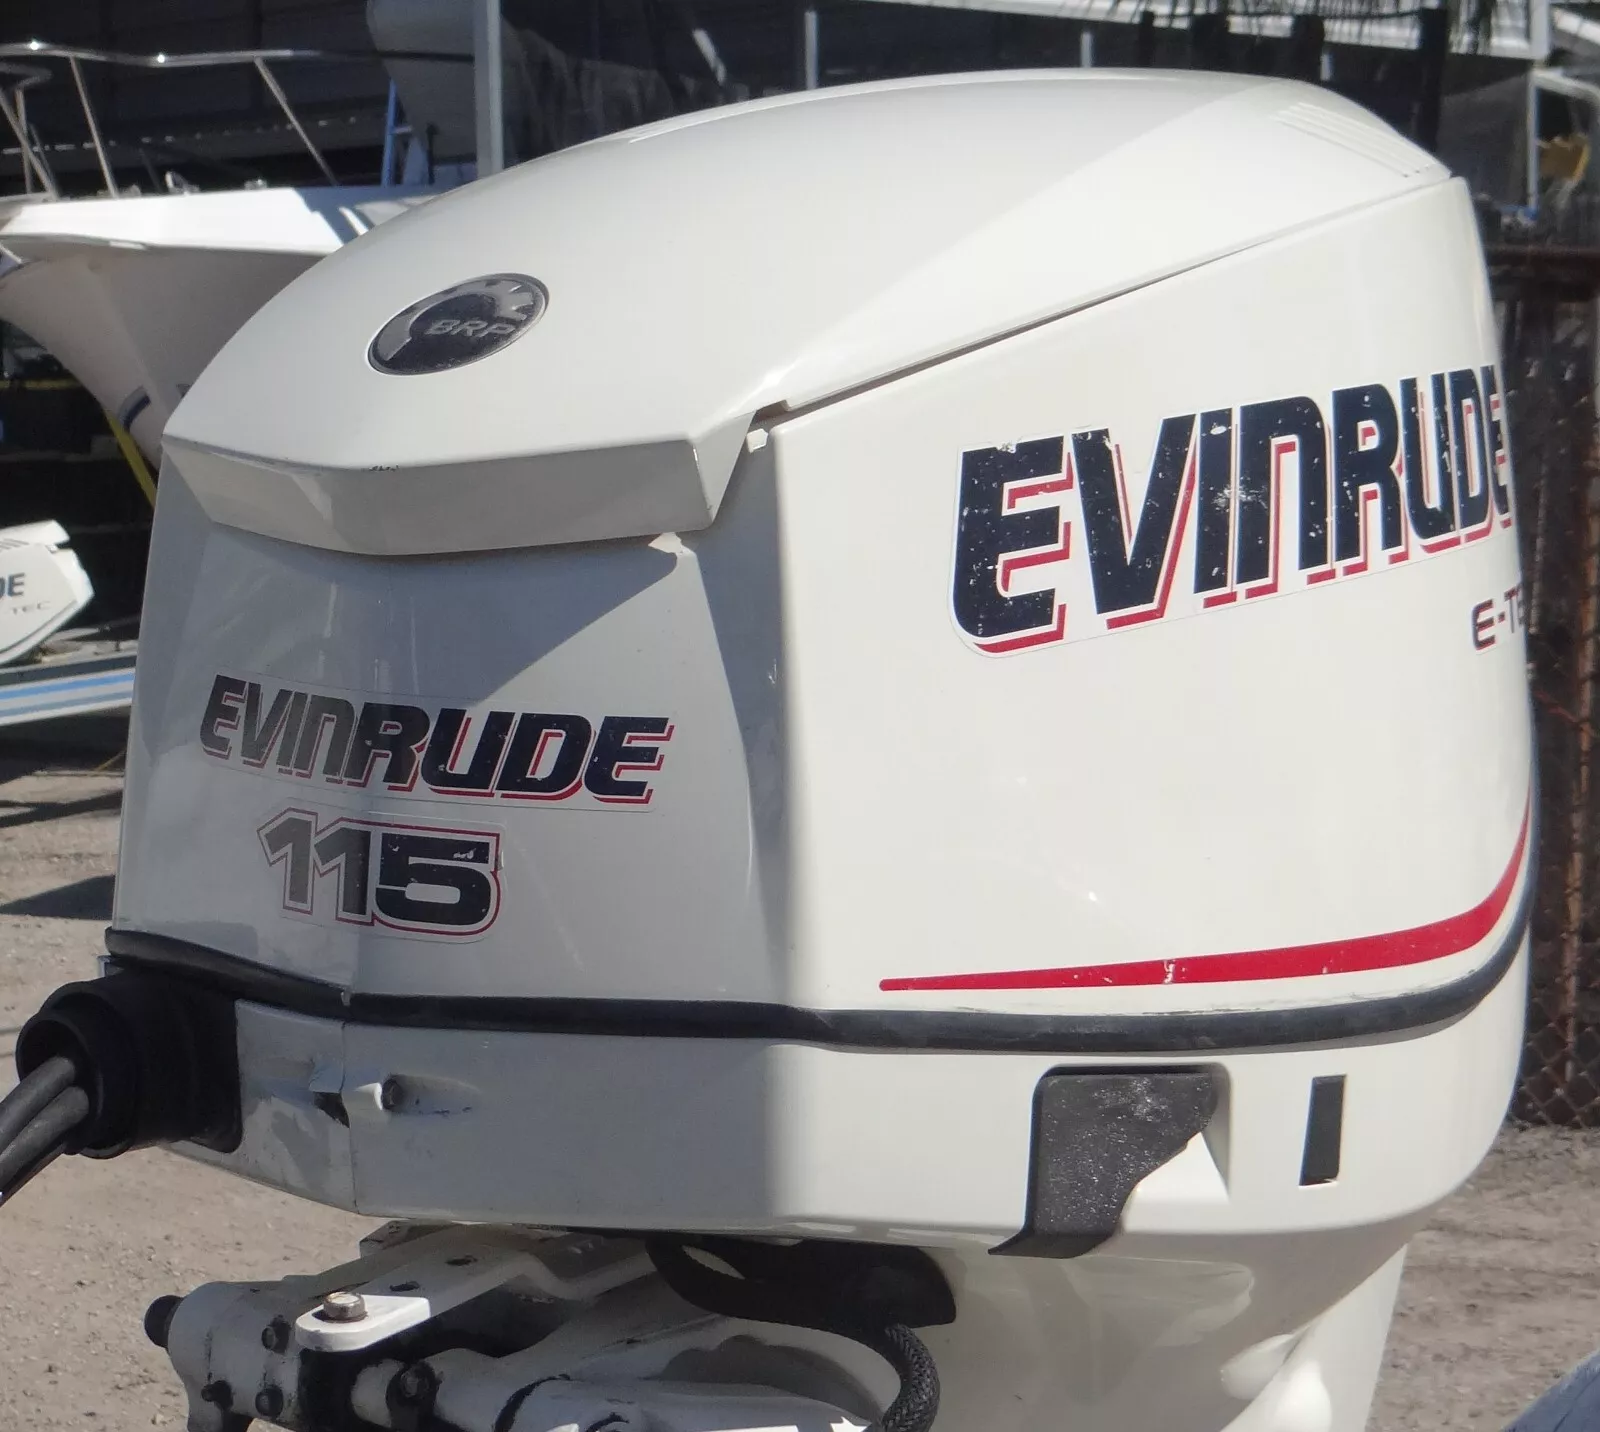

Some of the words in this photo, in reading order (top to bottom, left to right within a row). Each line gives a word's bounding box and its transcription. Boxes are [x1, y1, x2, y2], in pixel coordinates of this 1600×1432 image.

[424, 317, 515, 339] BRP
[953, 366, 1512, 653] EVINRUDE
[200, 674, 675, 804] EVINRUDE
[257, 807, 500, 936] 115
